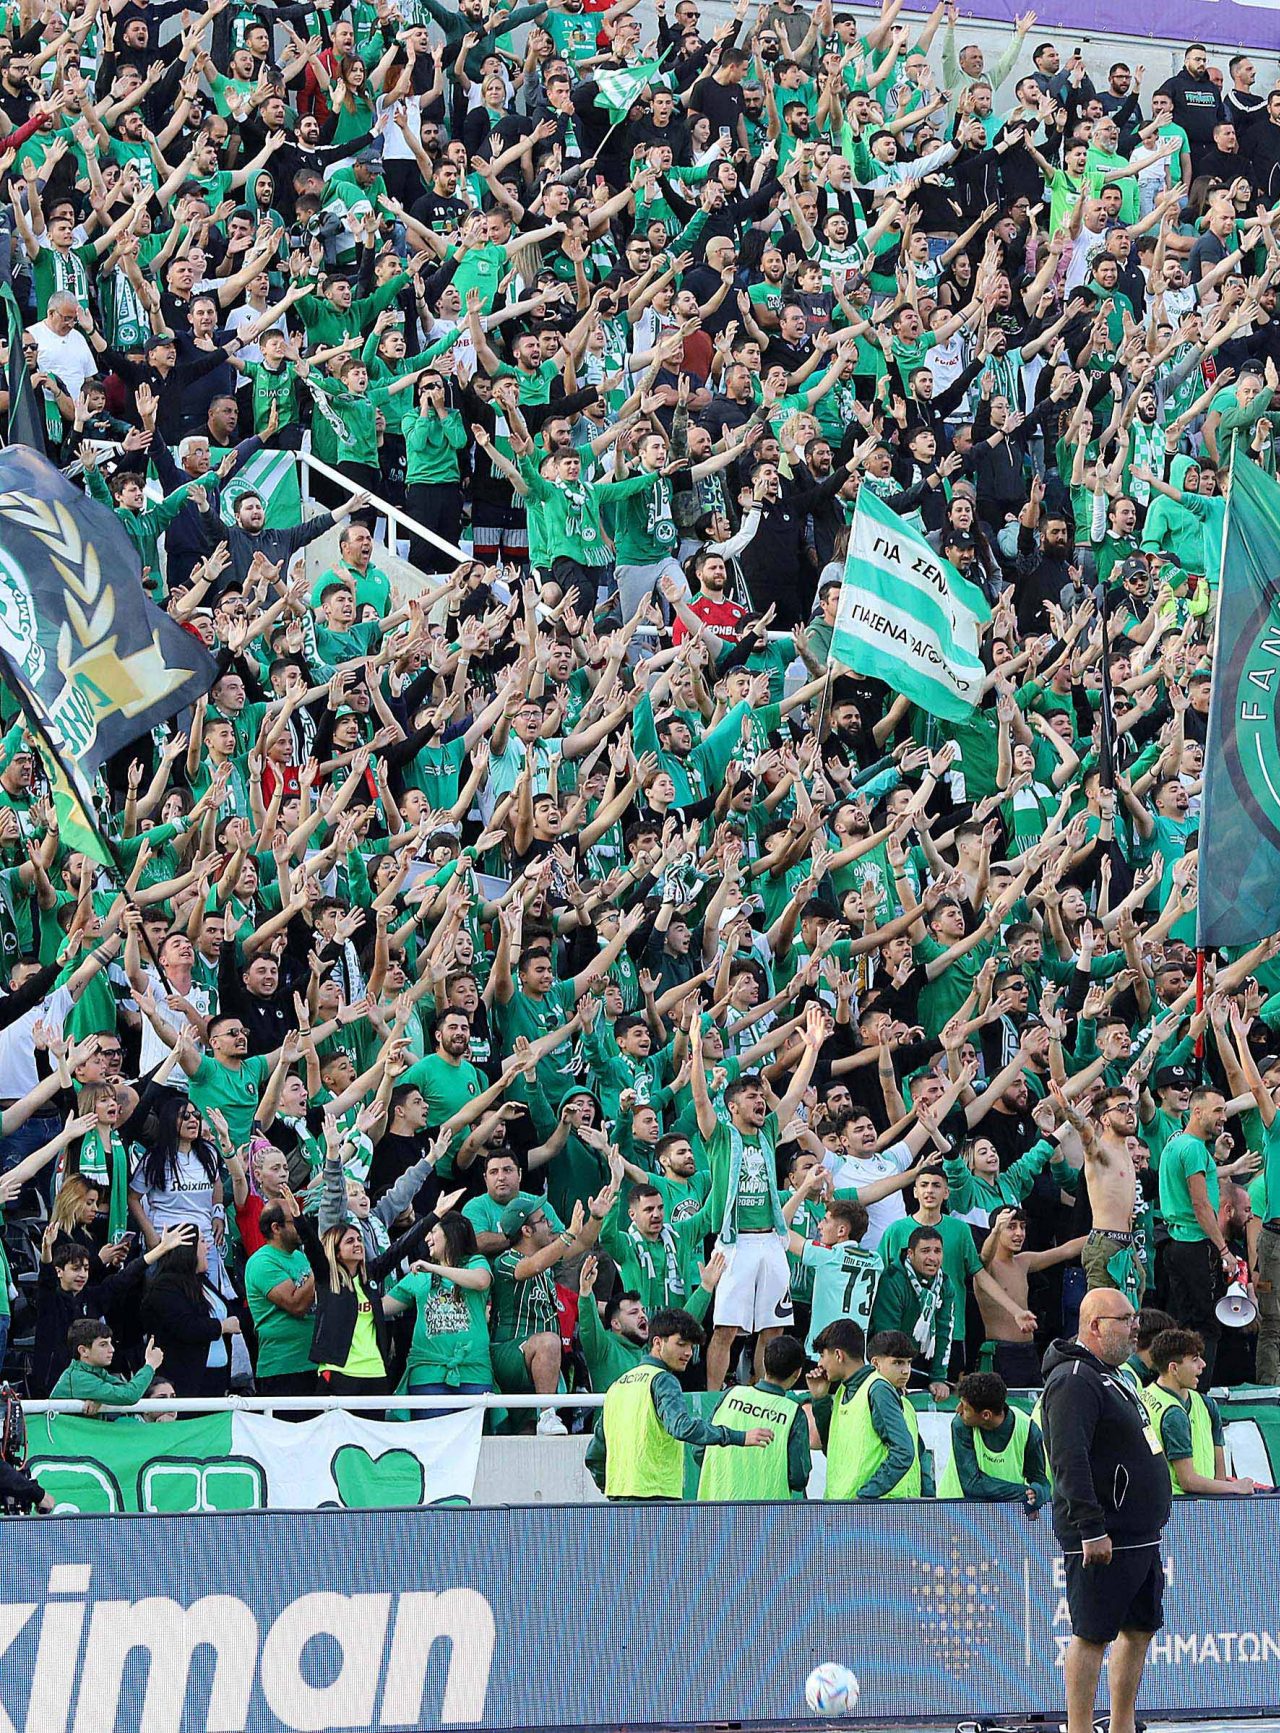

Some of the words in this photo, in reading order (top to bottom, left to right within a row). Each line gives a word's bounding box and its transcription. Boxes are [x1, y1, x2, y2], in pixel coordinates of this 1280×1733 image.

[258, 388, 290, 398] DIMCO
[873, 537, 901, 564] ΓΙΑ
[841, 1265, 877, 1317] 73
[615, 1371, 650, 1386] acron
[728, 1398, 787, 1426] macron
[1139, 1388, 1161, 1414] acron
